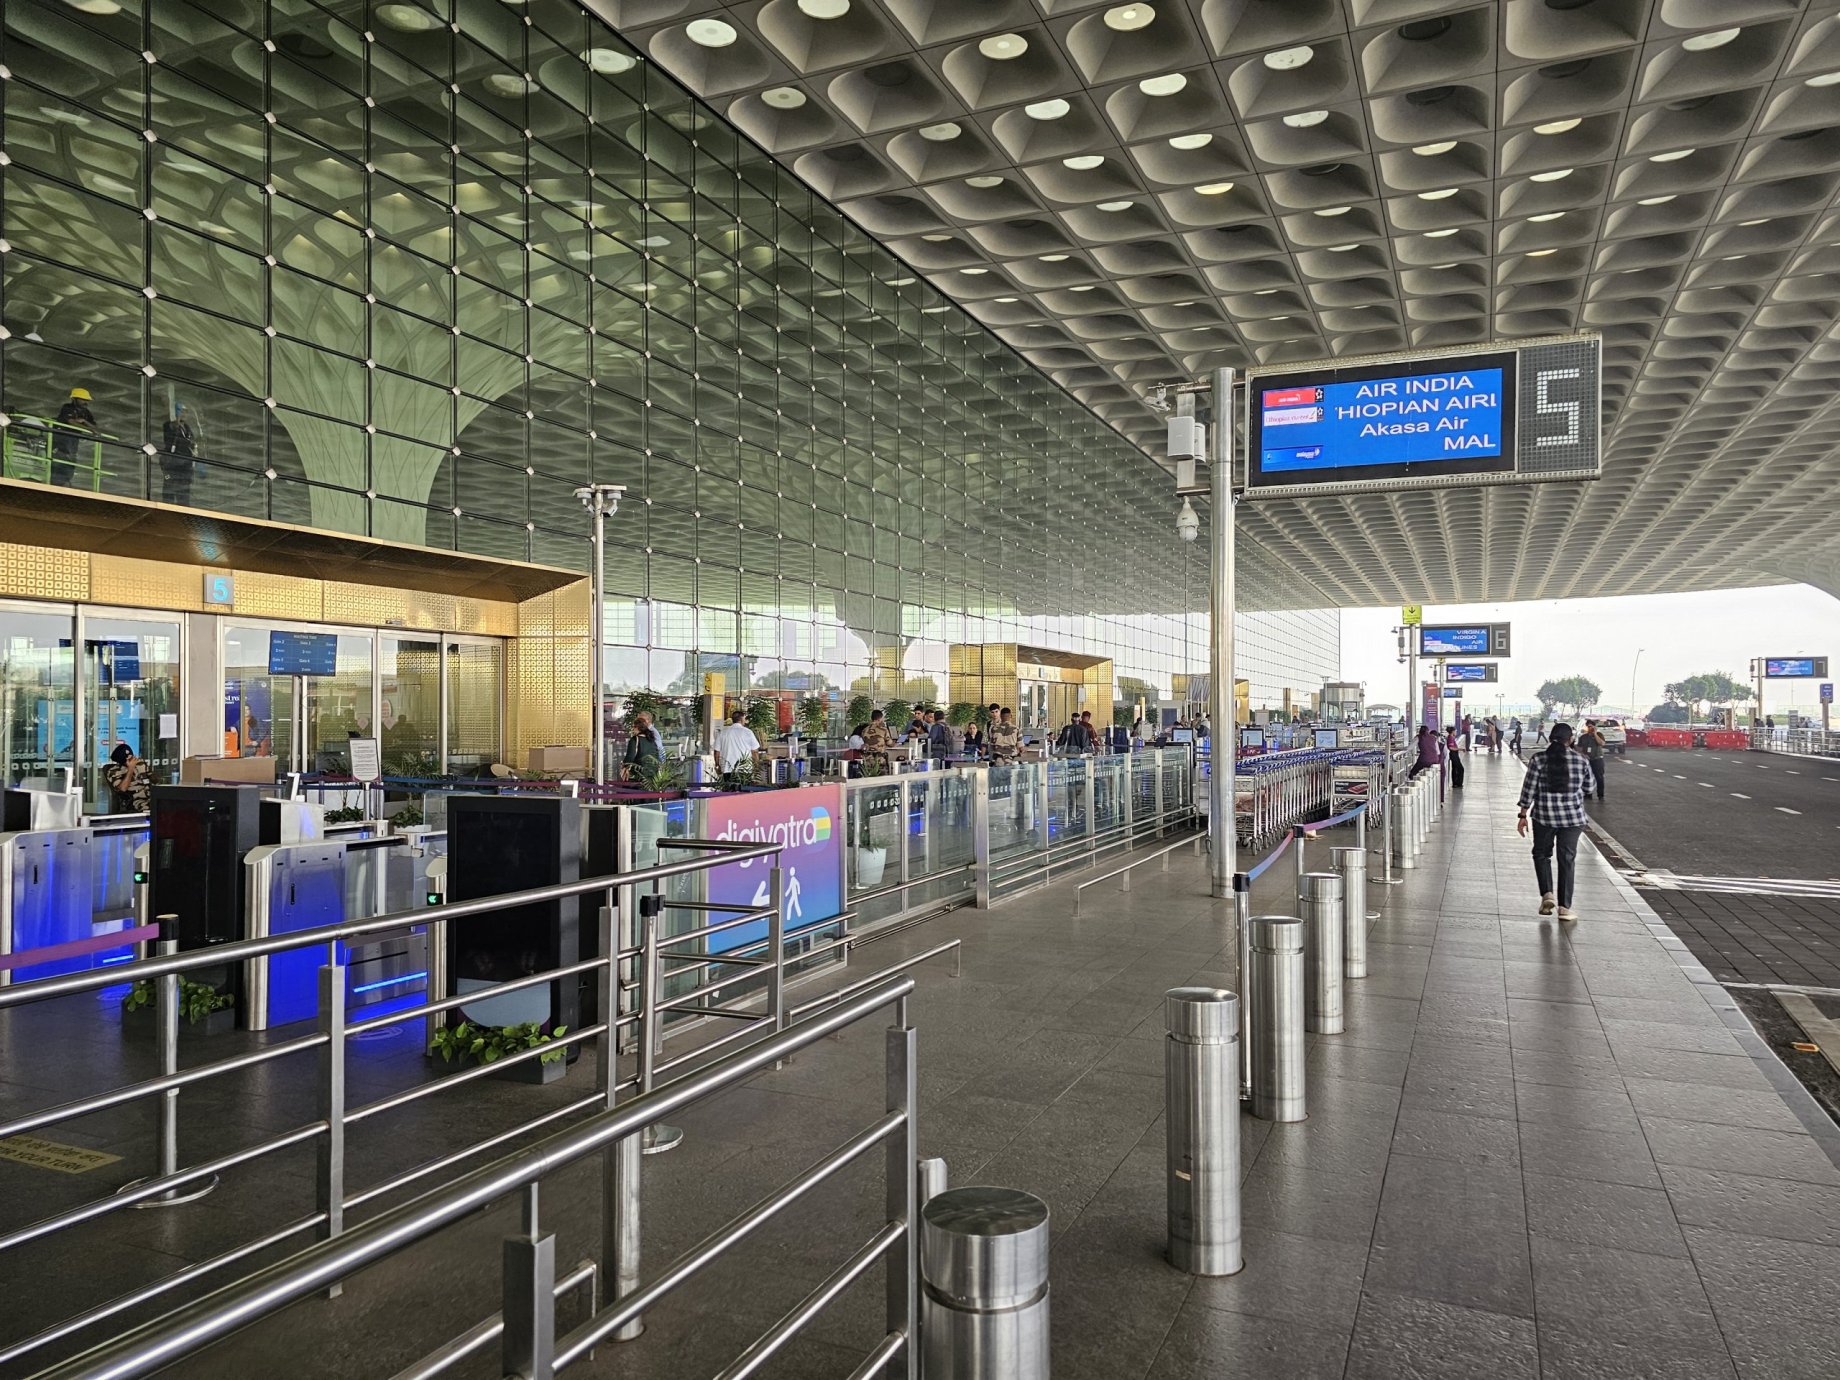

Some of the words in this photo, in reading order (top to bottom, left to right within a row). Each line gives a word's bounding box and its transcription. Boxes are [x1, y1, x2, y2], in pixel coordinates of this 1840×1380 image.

[1356, 383, 1398, 399] AIR
[1406, 376, 1474, 394] INDIA
[1335, 398, 1440, 420] HIOPIAN
[1536, 368, 1580, 447] 5
[1360, 422, 1430, 437] Akasa
[1435, 416, 1469, 432] Air
[1444, 434, 1497, 451] MAL
[212, 578, 228, 602] 5
[1495, 630, 1507, 650] 6
[1489, 666, 1496, 679] 7
[47, 1159, 87, 1170] TURN
